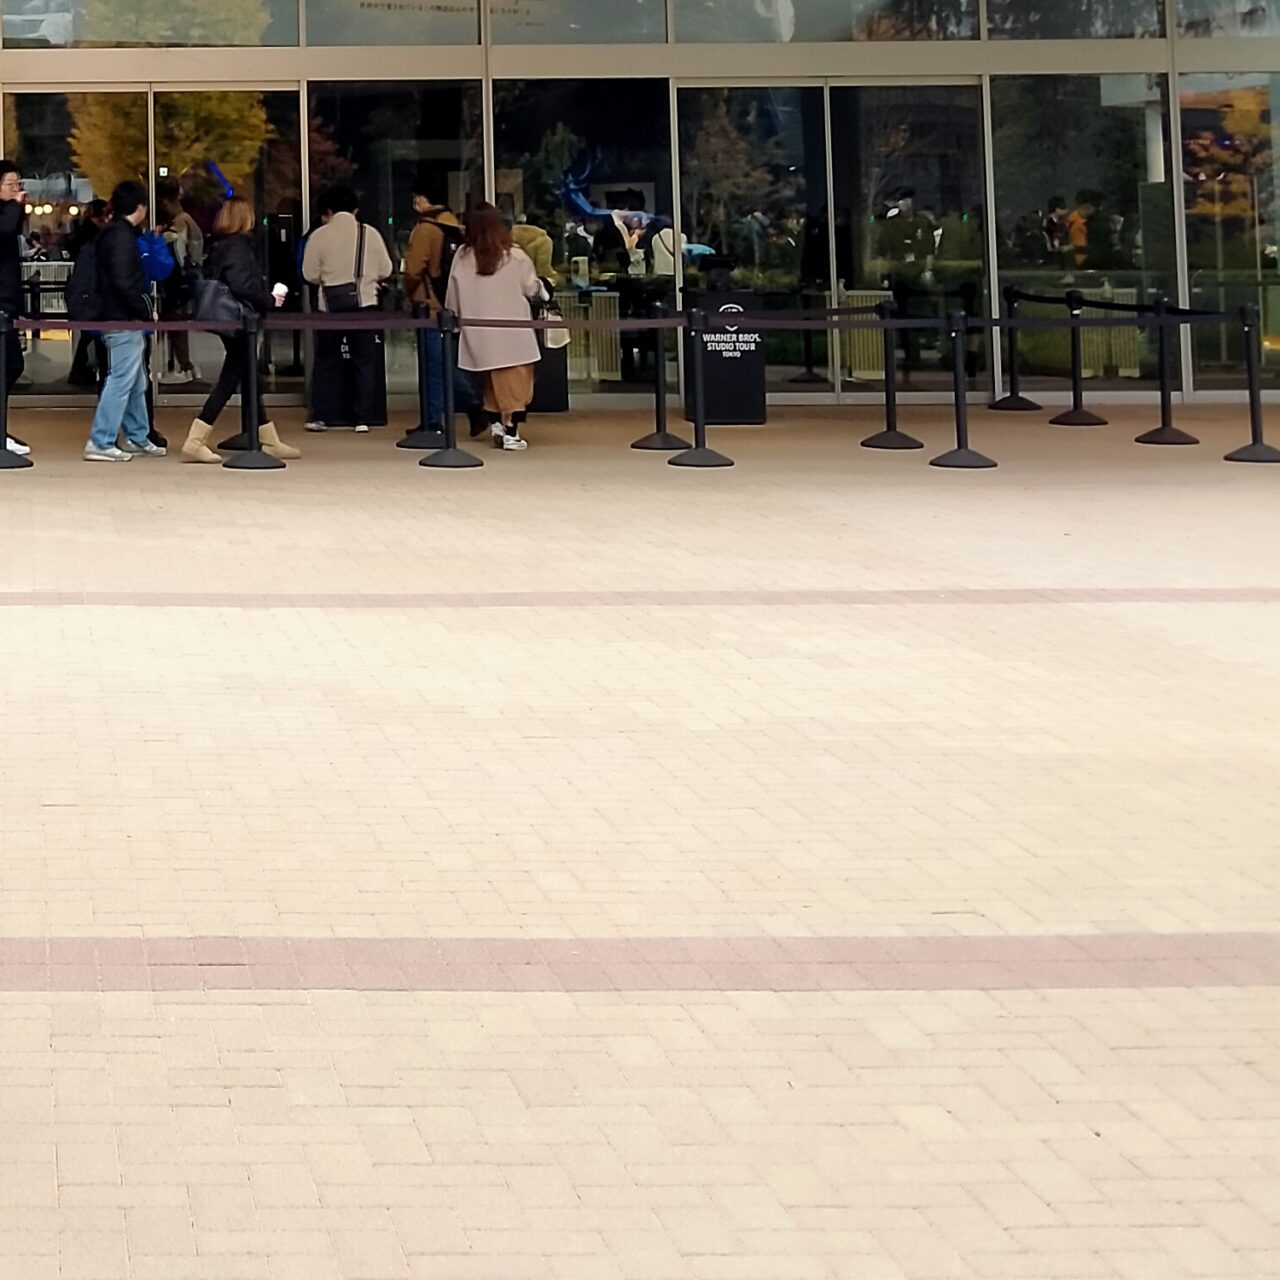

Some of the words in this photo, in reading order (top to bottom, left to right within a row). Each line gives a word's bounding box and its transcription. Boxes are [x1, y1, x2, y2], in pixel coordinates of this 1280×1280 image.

[702, 333, 737, 342] WARNER
[707, 342, 734, 351] STUDIO
[735, 342, 756, 351] TOUR
